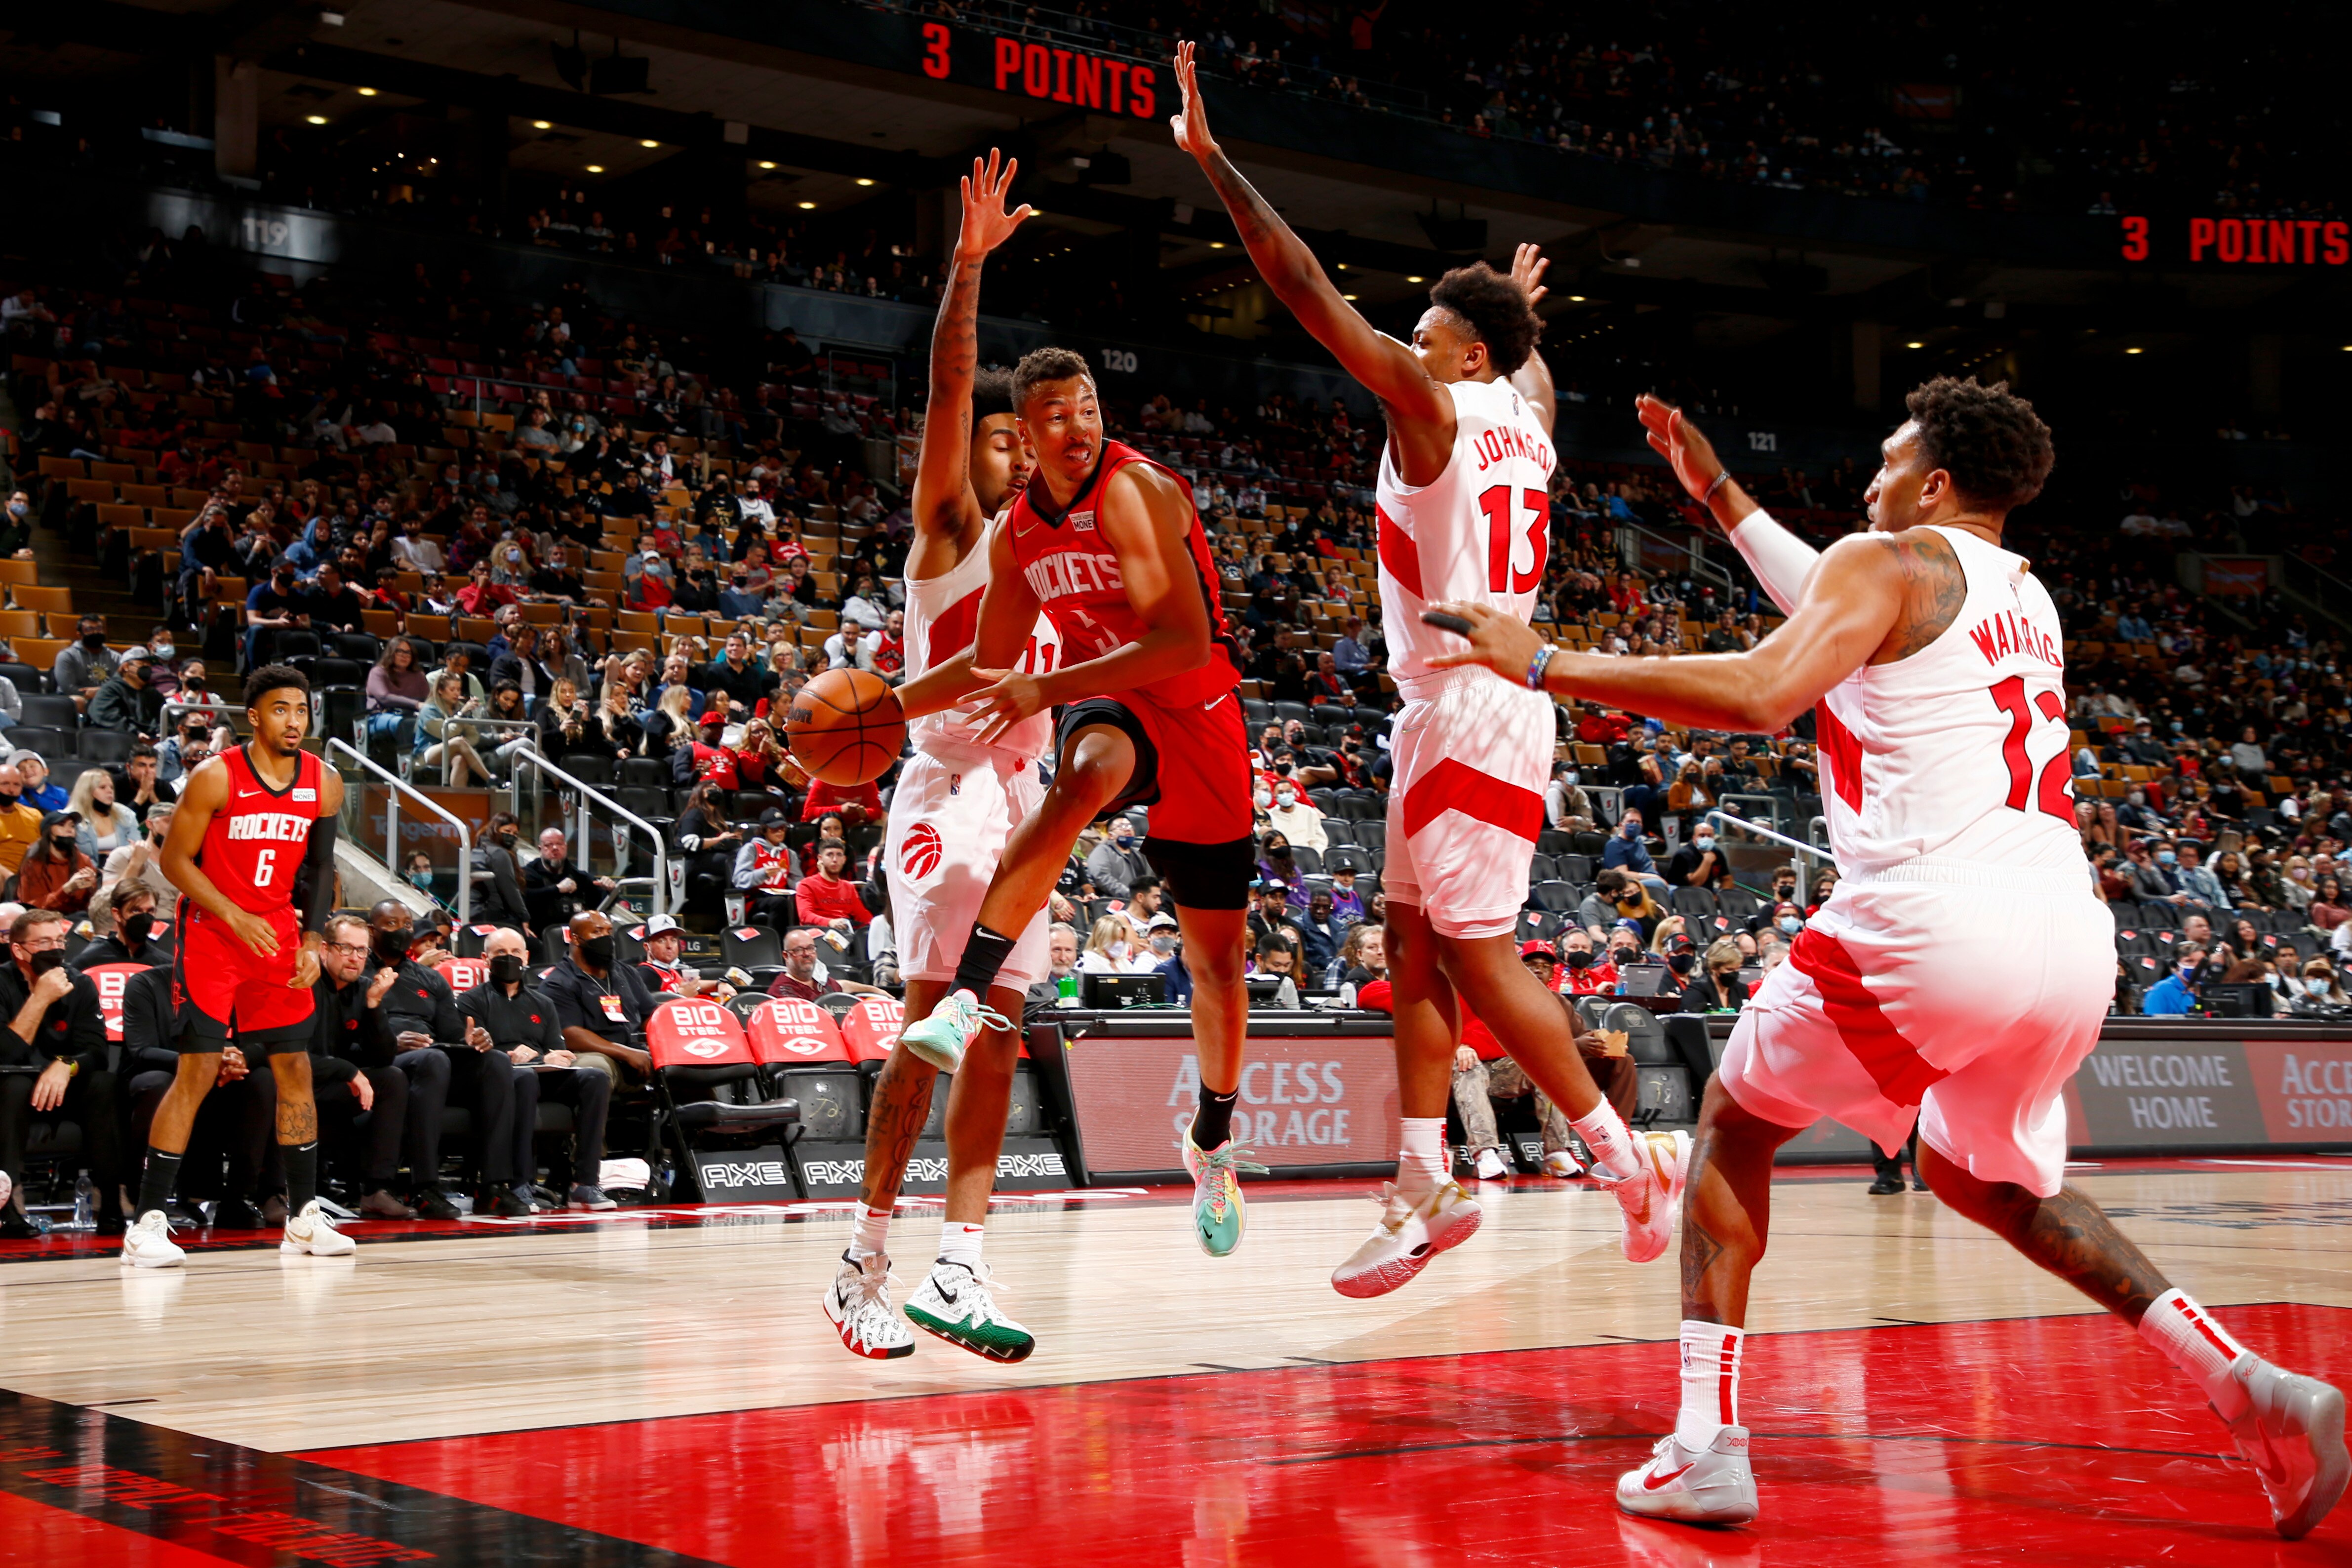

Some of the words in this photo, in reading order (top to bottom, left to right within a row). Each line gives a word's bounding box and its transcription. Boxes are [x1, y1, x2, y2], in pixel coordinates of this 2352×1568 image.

[921, 23, 952, 80] 3
[994, 37, 1156, 119] POINTS
[242, 217, 288, 246] 119
[2120, 215, 2150, 262] 3
[2189, 217, 2351, 266] POINTS
[1101, 348, 1138, 373] 120
[1474, 425, 1555, 471] JOHNSO
[1747, 431, 1776, 451] 121
[1073, 519, 1094, 530] MONE
[1478, 484, 1550, 595] 13
[1024, 552, 1124, 603] ROCKETS
[1990, 675, 2079, 831] 12
[228, 812, 312, 843] ROCKETS
[371, 815, 471, 842] Tngerin
[254, 849, 276, 886] 6
[631, 902, 642, 911] LG
[687, 941, 701, 951] LG
[671, 1005, 722, 1025] BIO
[771, 1004, 819, 1024] BIO
[871, 1023, 903, 1033] STE
[678, 1027, 726, 1036] STEEL
[777, 1025, 823, 1035] STEEL
[1167, 1054, 1344, 1107] ACESS
[2090, 1054, 2233, 1087] WELCOME
[2128, 1096, 2218, 1129] HOME
[1172, 1109, 1351, 1149] SORAGE
[702, 1161, 787, 1189] AXE
[904, 1158, 948, 1182] AX
[996, 1153, 1067, 1178] AXE
